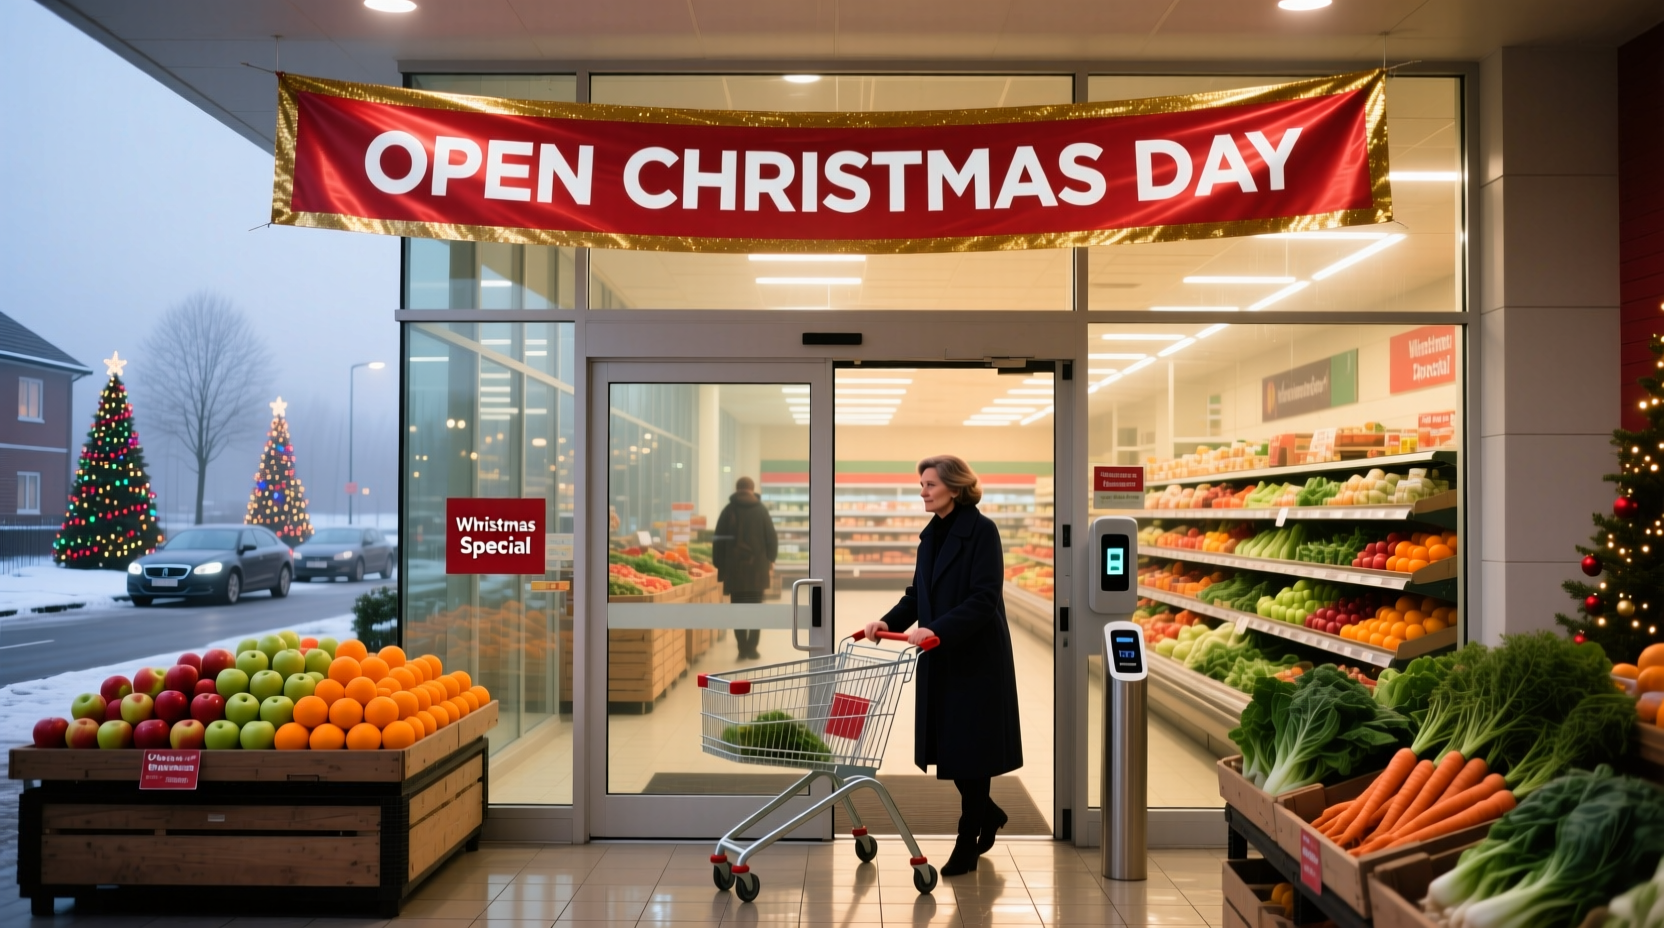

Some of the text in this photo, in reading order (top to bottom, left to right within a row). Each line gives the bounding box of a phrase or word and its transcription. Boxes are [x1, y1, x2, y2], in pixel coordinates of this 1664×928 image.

[364, 127, 1303, 214] OPEN CHRISTMAS DAY
[460, 536, 531, 559] Special
